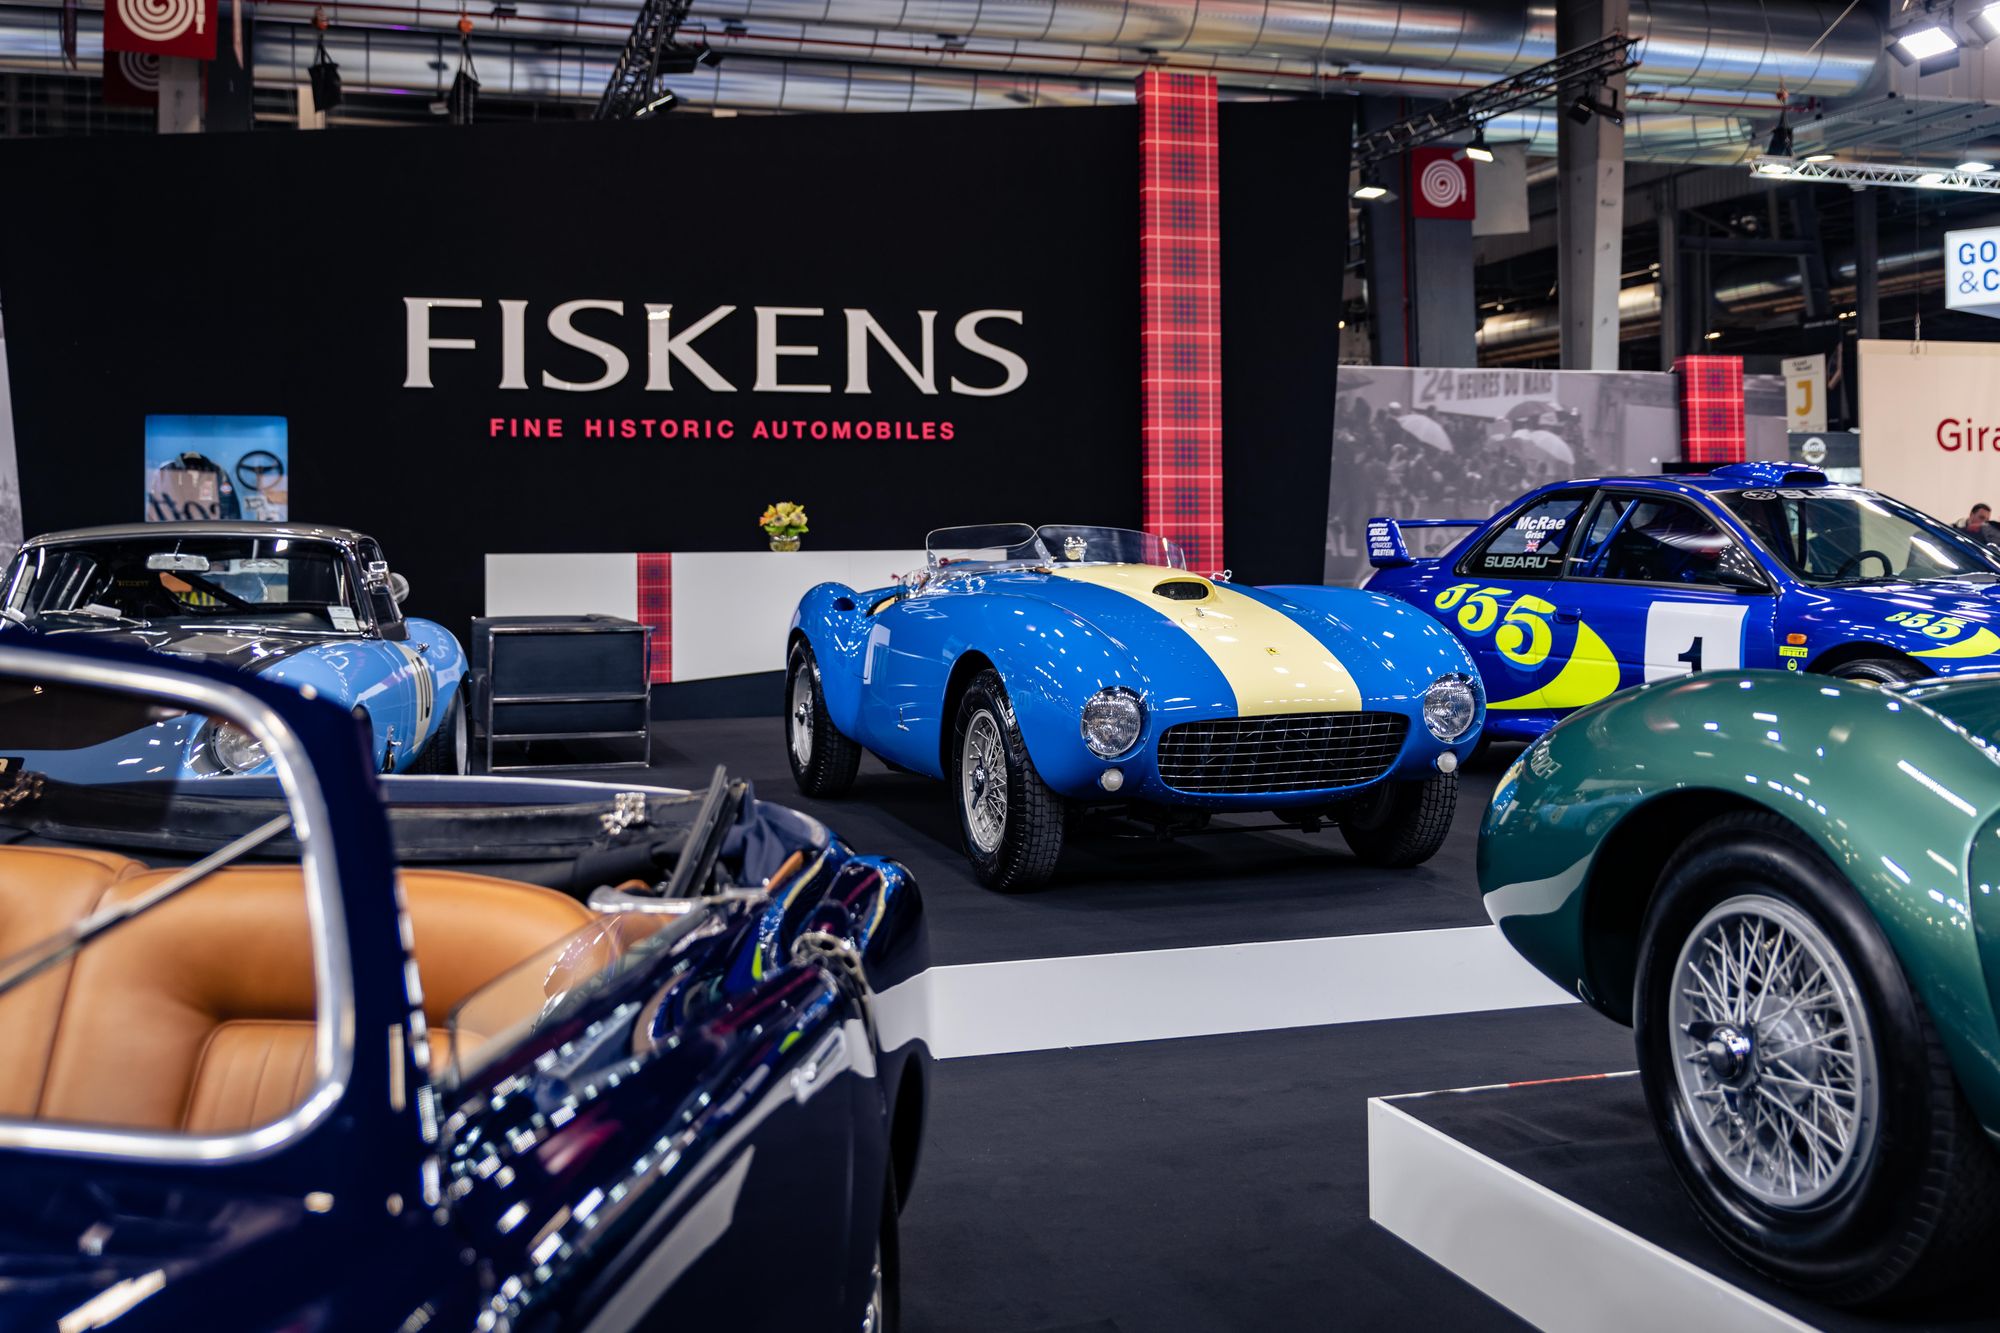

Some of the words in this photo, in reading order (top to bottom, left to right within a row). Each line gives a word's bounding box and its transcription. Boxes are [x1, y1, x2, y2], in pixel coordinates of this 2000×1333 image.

[402, 297, 1029, 397] FISKENS
[1420, 370, 1454, 402] 24
[1795, 380, 1812, 416] J
[490, 418, 563, 437] FINE
[584, 419, 735, 438] HISTORIC
[752, 420, 955, 440] AUTOMOBILES
[1515, 516, 1566, 530] McRae
[1525, 531, 1546, 539] Grist
[1484, 556, 1549, 568] SUBARU
[1435, 583, 1558, 668] 555
[1885, 612, 1968, 639] 555
[1678, 636, 1703, 673] 1
